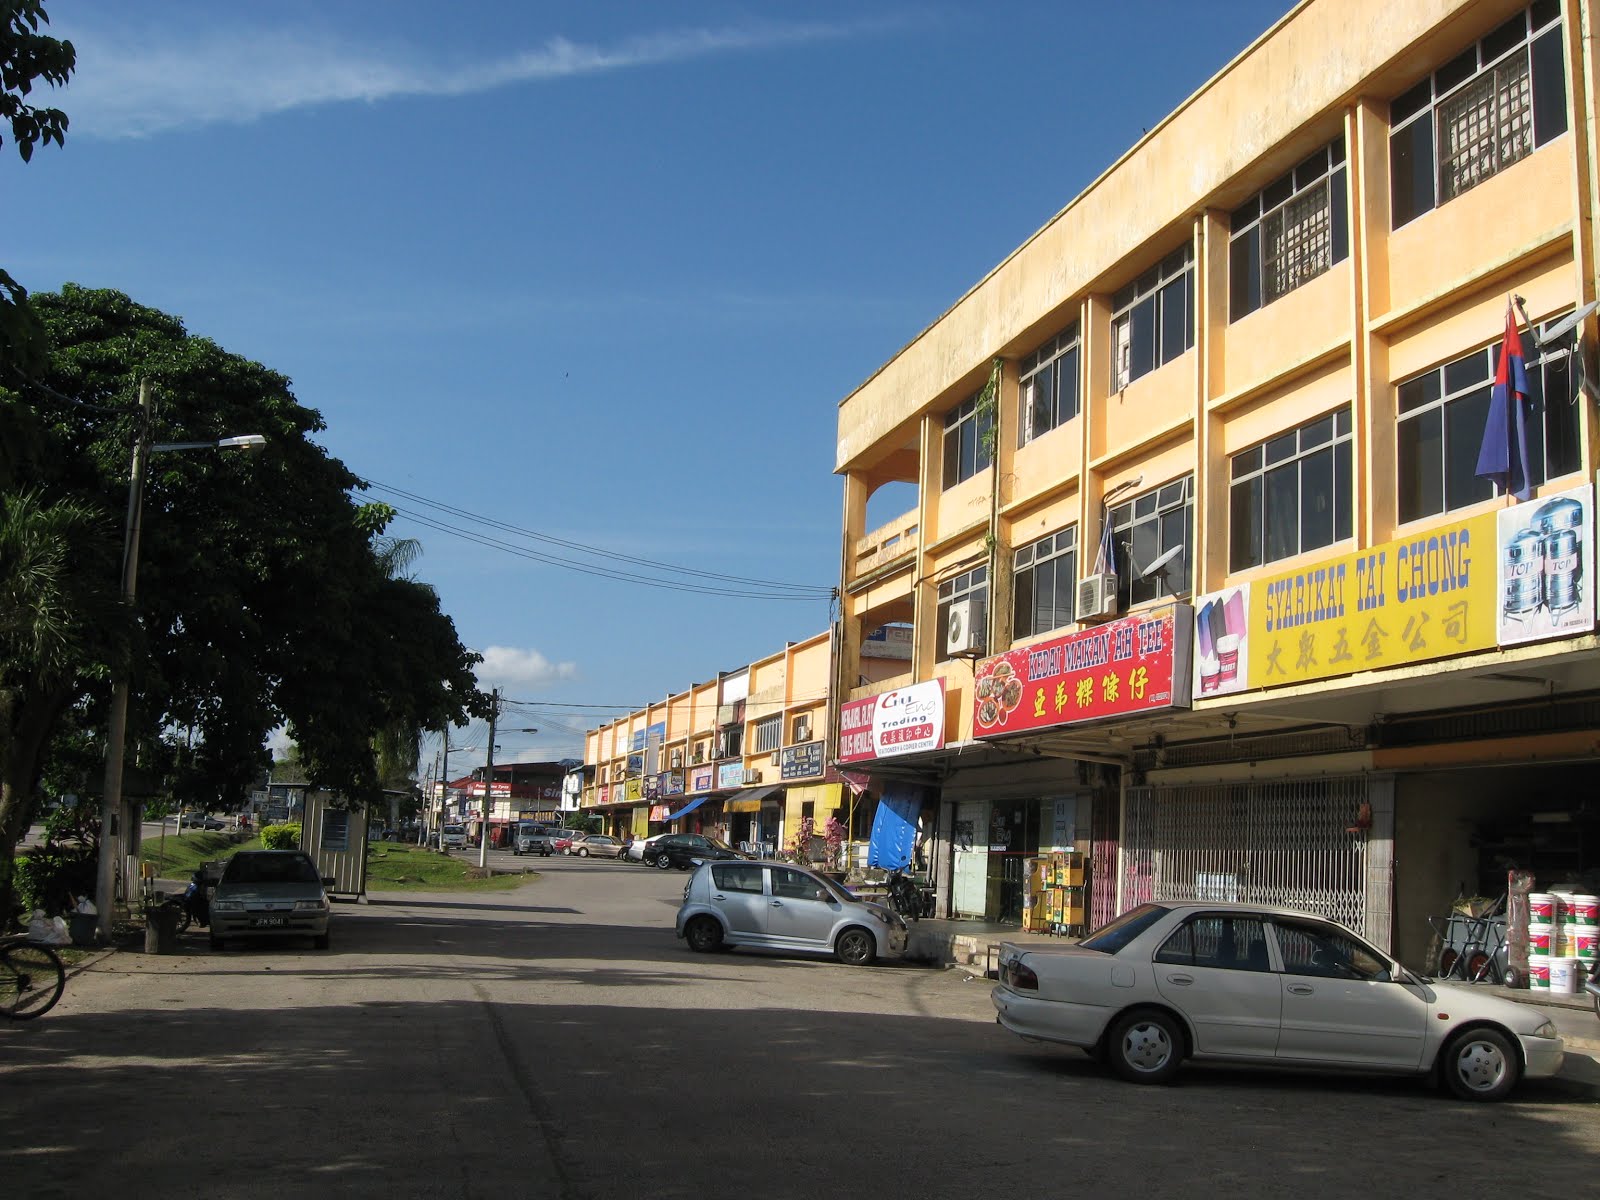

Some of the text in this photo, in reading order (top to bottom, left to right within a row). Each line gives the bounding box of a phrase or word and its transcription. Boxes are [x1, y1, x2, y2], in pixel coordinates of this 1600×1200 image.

[1510, 561, 1533, 577] TOP
[1553, 559, 1571, 571] TOP
[1266, 528, 1471, 632] SYARIKAT TAI CHONG
[1028, 619, 1163, 682] KEDAI MAKAN AH TEE
[905, 700, 936, 715] Eng
[882, 715, 926, 729] Trading
